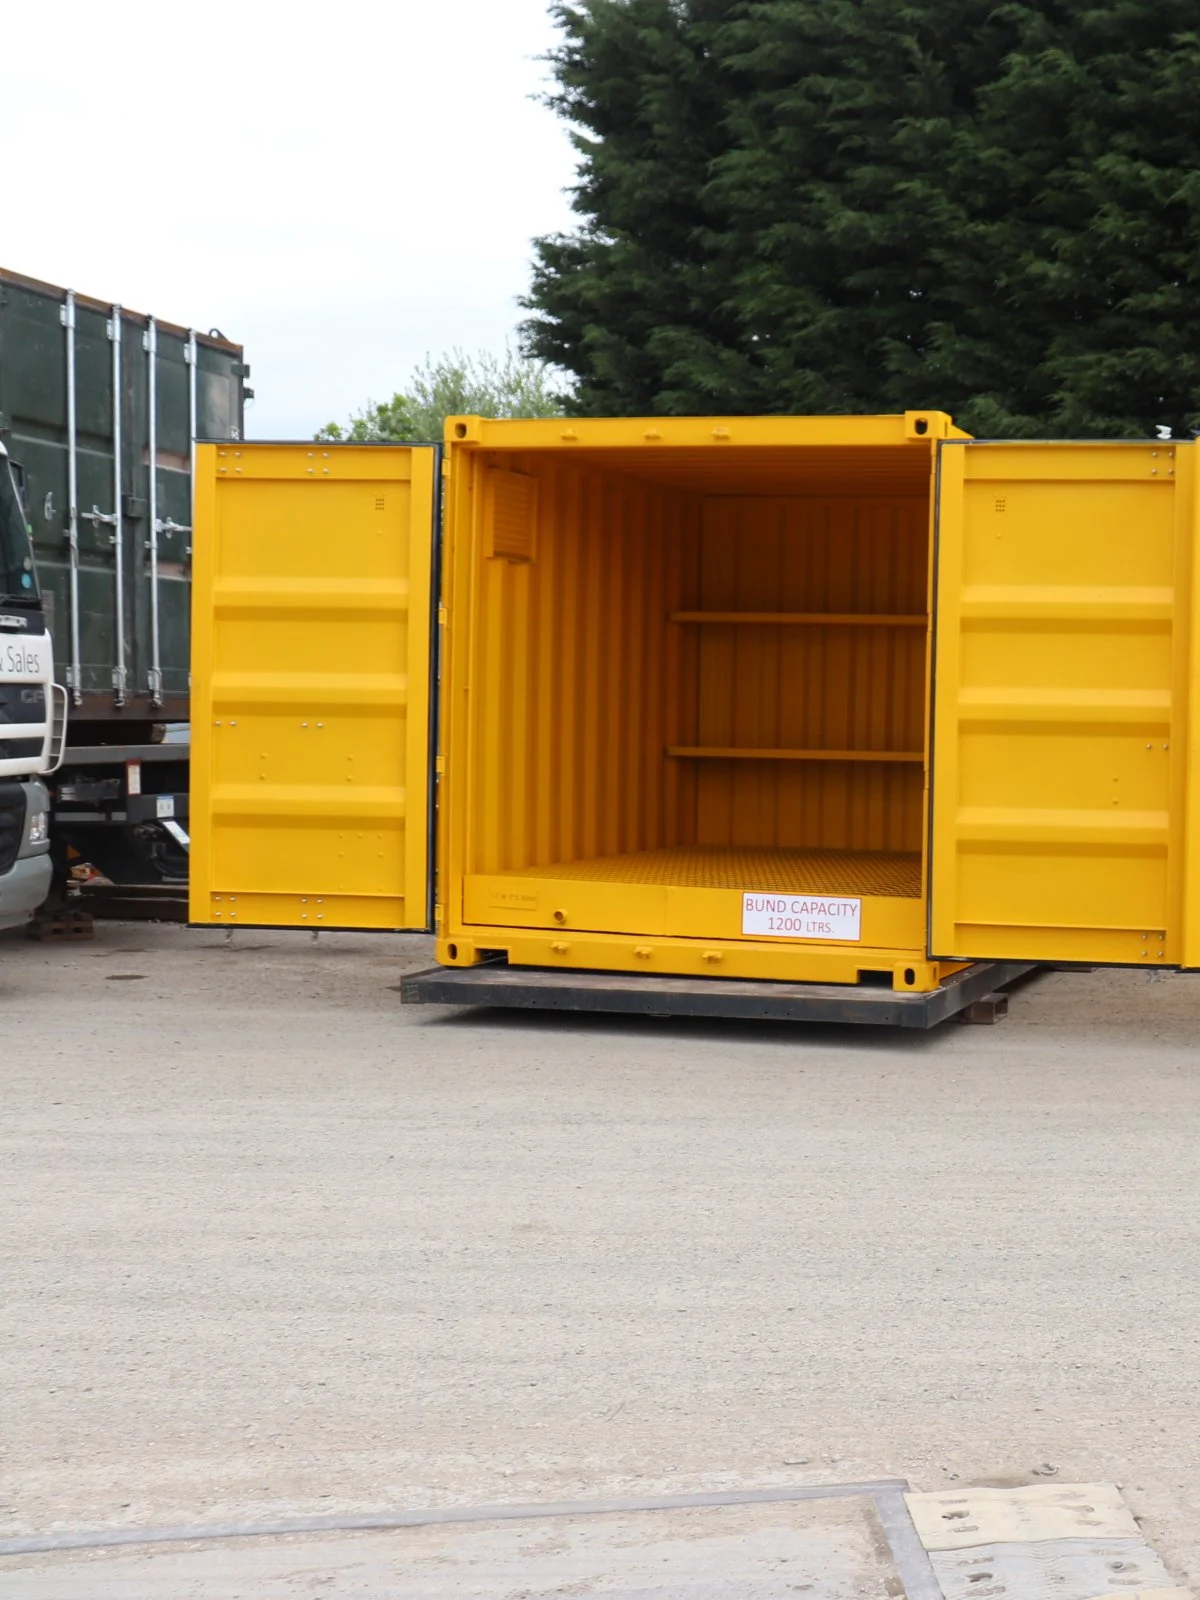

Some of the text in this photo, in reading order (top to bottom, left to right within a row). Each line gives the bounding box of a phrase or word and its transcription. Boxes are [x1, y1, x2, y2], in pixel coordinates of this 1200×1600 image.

[6, 645, 40, 673] Sales
[745, 898, 858, 917] BUND CAPACITY
[767, 917, 835, 934] 1200 LTRS.
